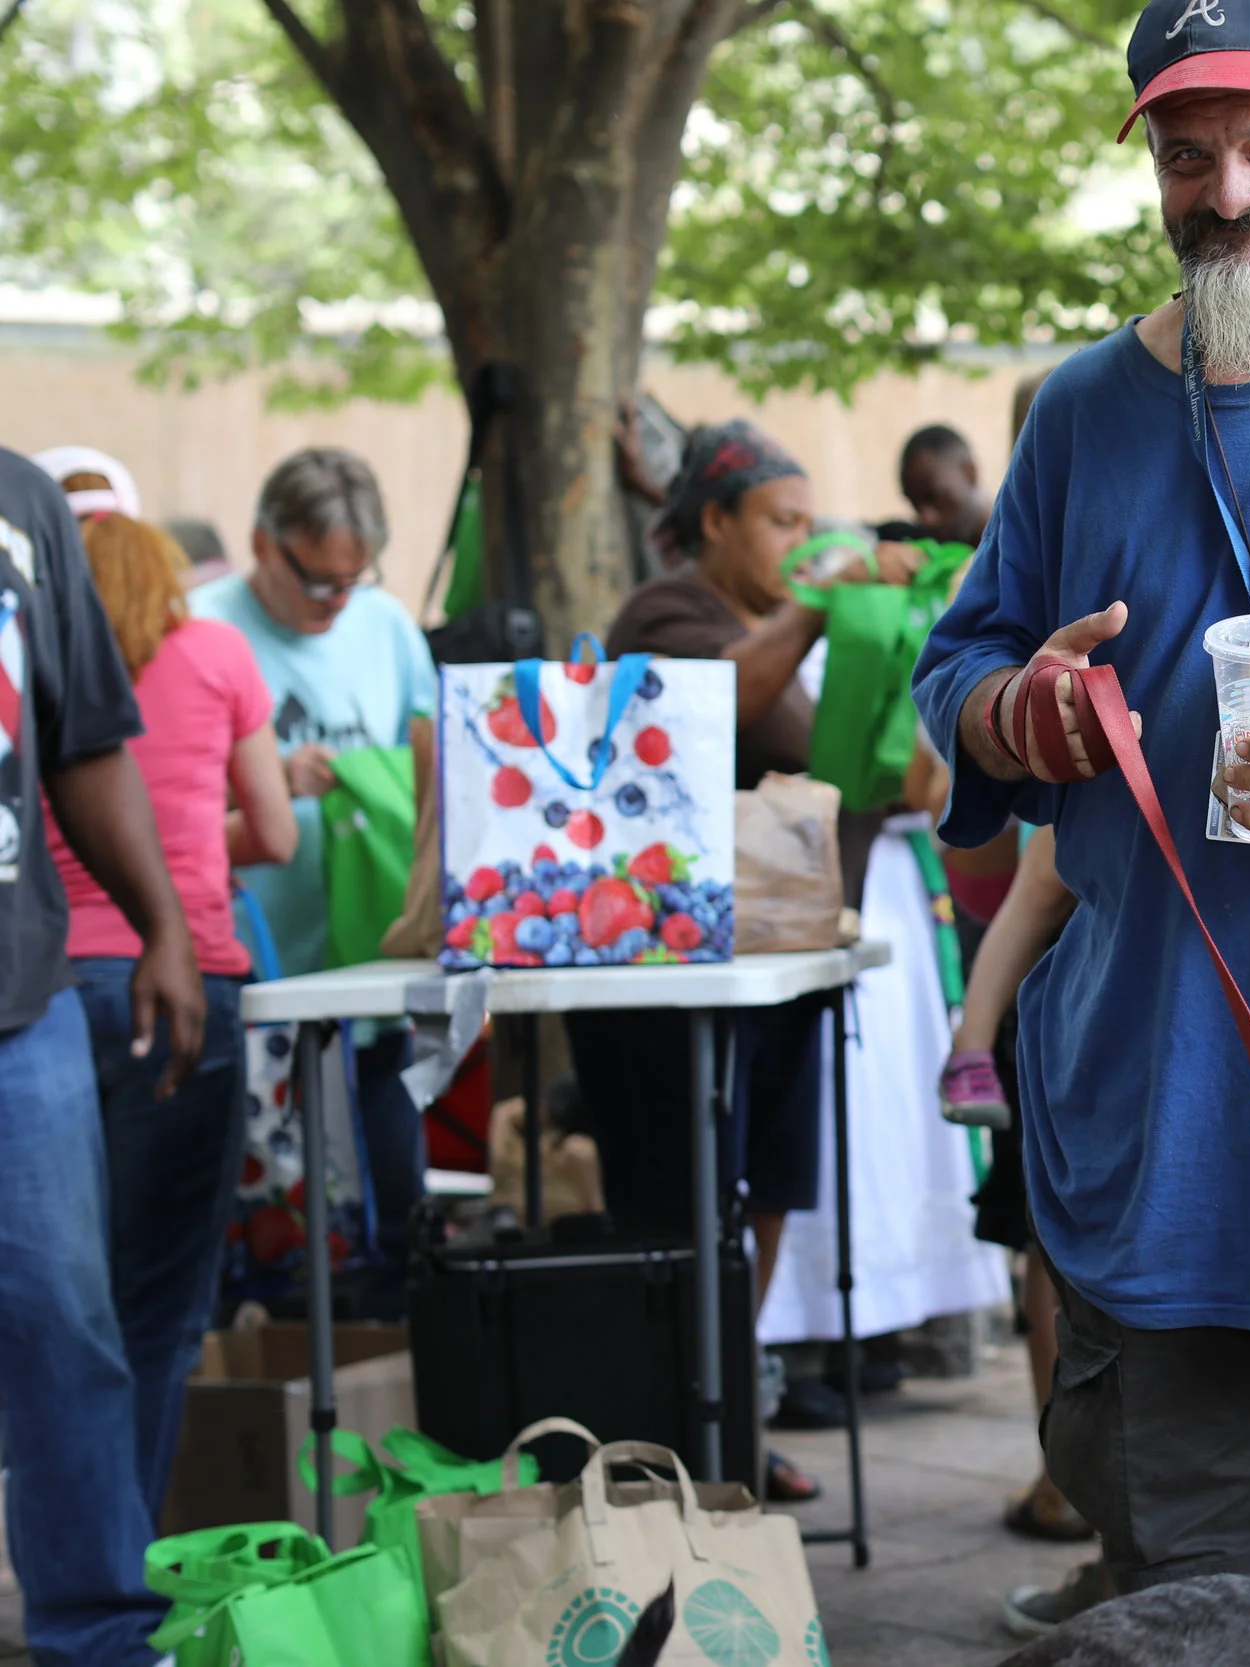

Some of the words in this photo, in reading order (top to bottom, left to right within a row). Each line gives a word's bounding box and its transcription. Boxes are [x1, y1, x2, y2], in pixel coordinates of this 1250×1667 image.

[1165, 0, 1226, 40] A
[1188, 368, 1197, 392] State
[1190, 390, 1201, 441] University
